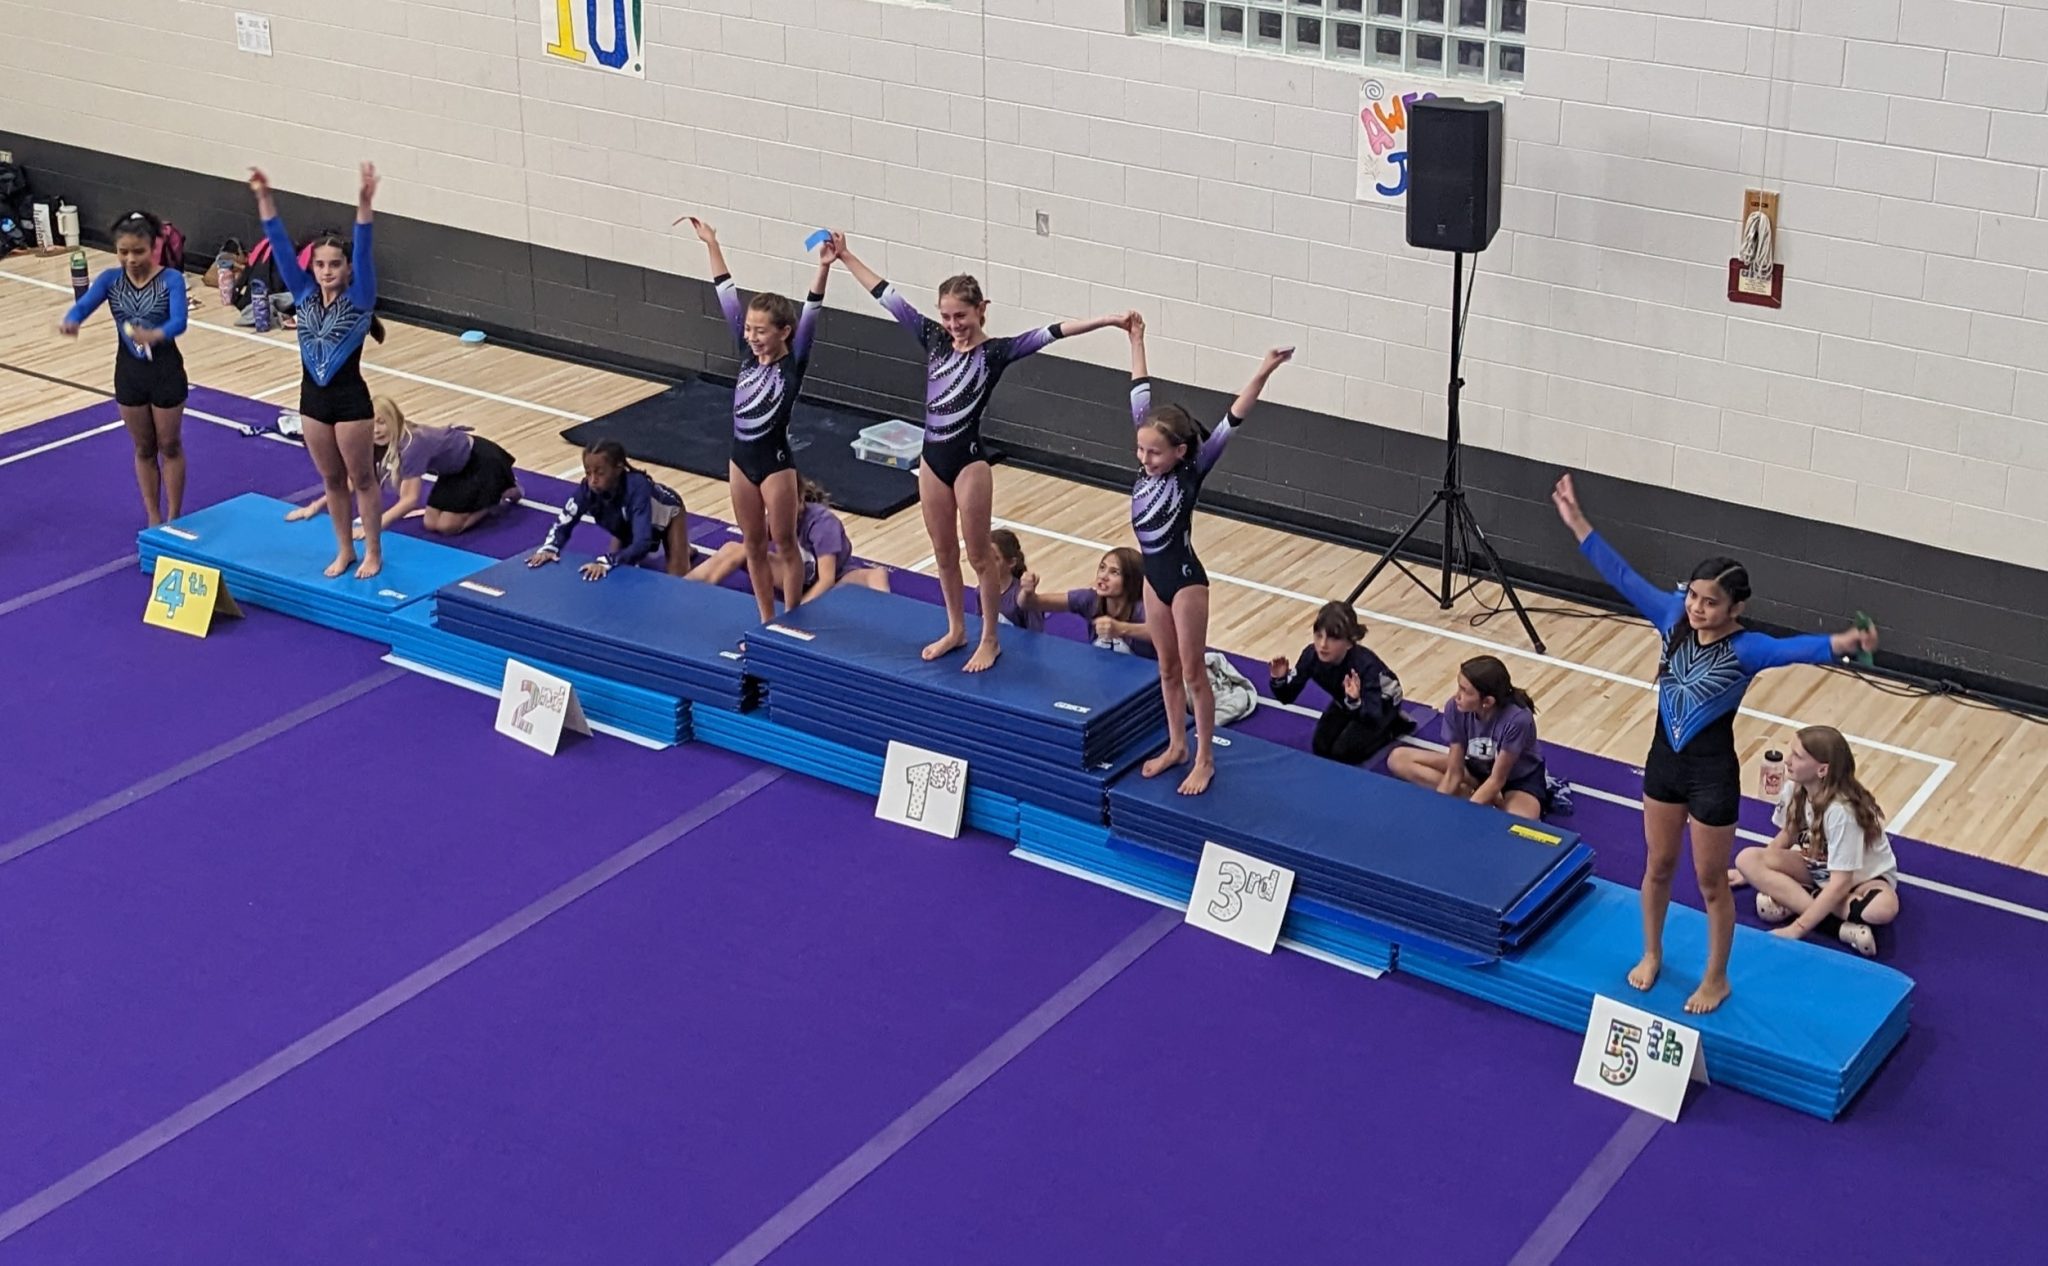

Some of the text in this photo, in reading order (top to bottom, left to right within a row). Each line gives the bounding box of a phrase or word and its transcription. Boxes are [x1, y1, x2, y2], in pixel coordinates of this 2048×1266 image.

[154, 568, 208, 619] 4th
[511, 679, 566, 735] 2nd
[906, 761, 960, 821] 1st
[1208, 861, 1280, 922] 3rd
[1600, 1018, 1684, 1086] 5th
